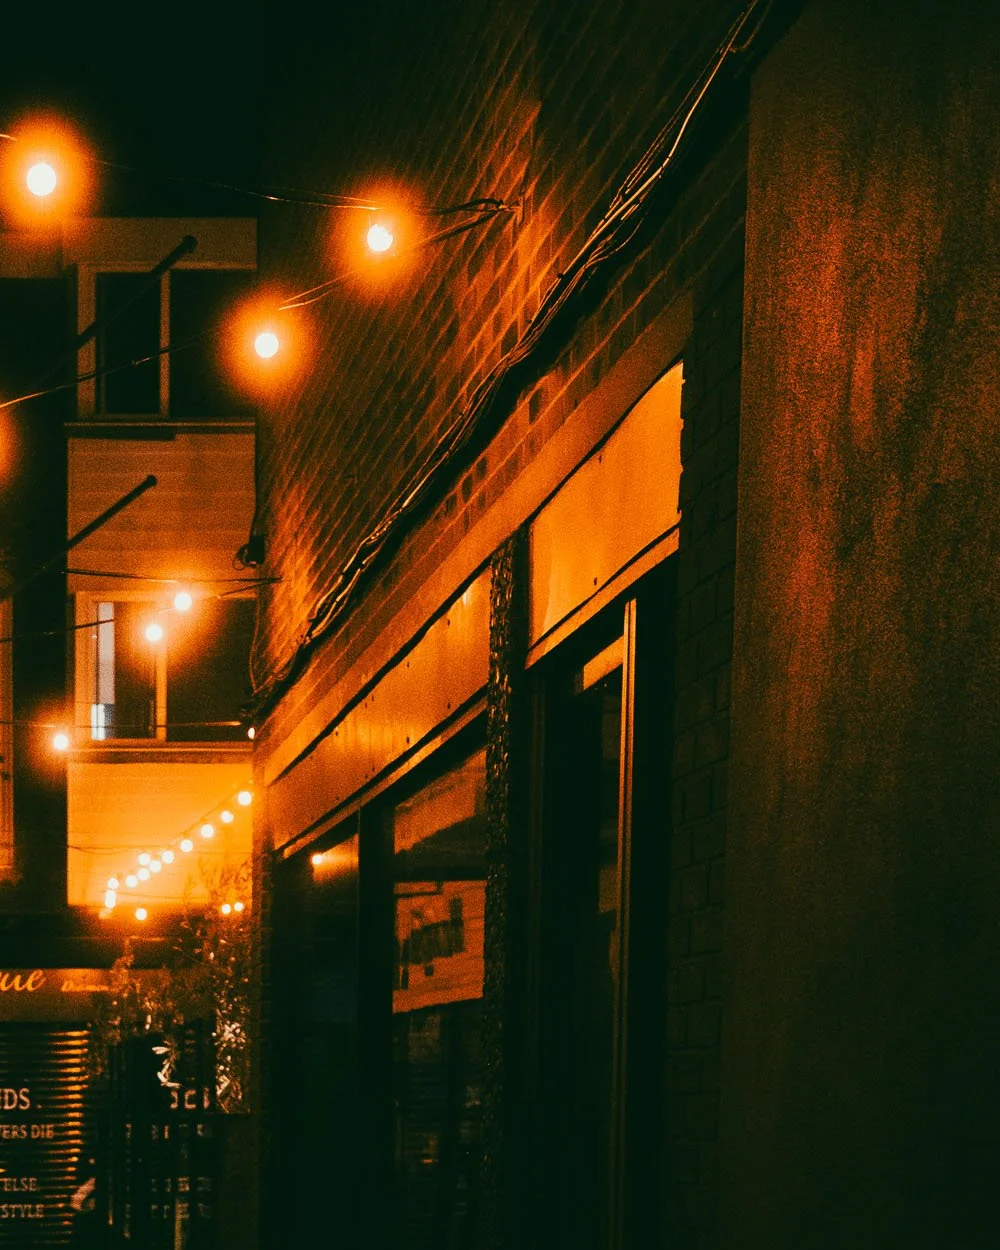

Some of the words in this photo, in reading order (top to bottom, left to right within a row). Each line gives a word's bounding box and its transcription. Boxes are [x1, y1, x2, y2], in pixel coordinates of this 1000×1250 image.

[31, 1123, 55, 1139] DIE
[3, 1176, 40, 1193] ELSE
[0, 1203, 45, 1219] STYLE
